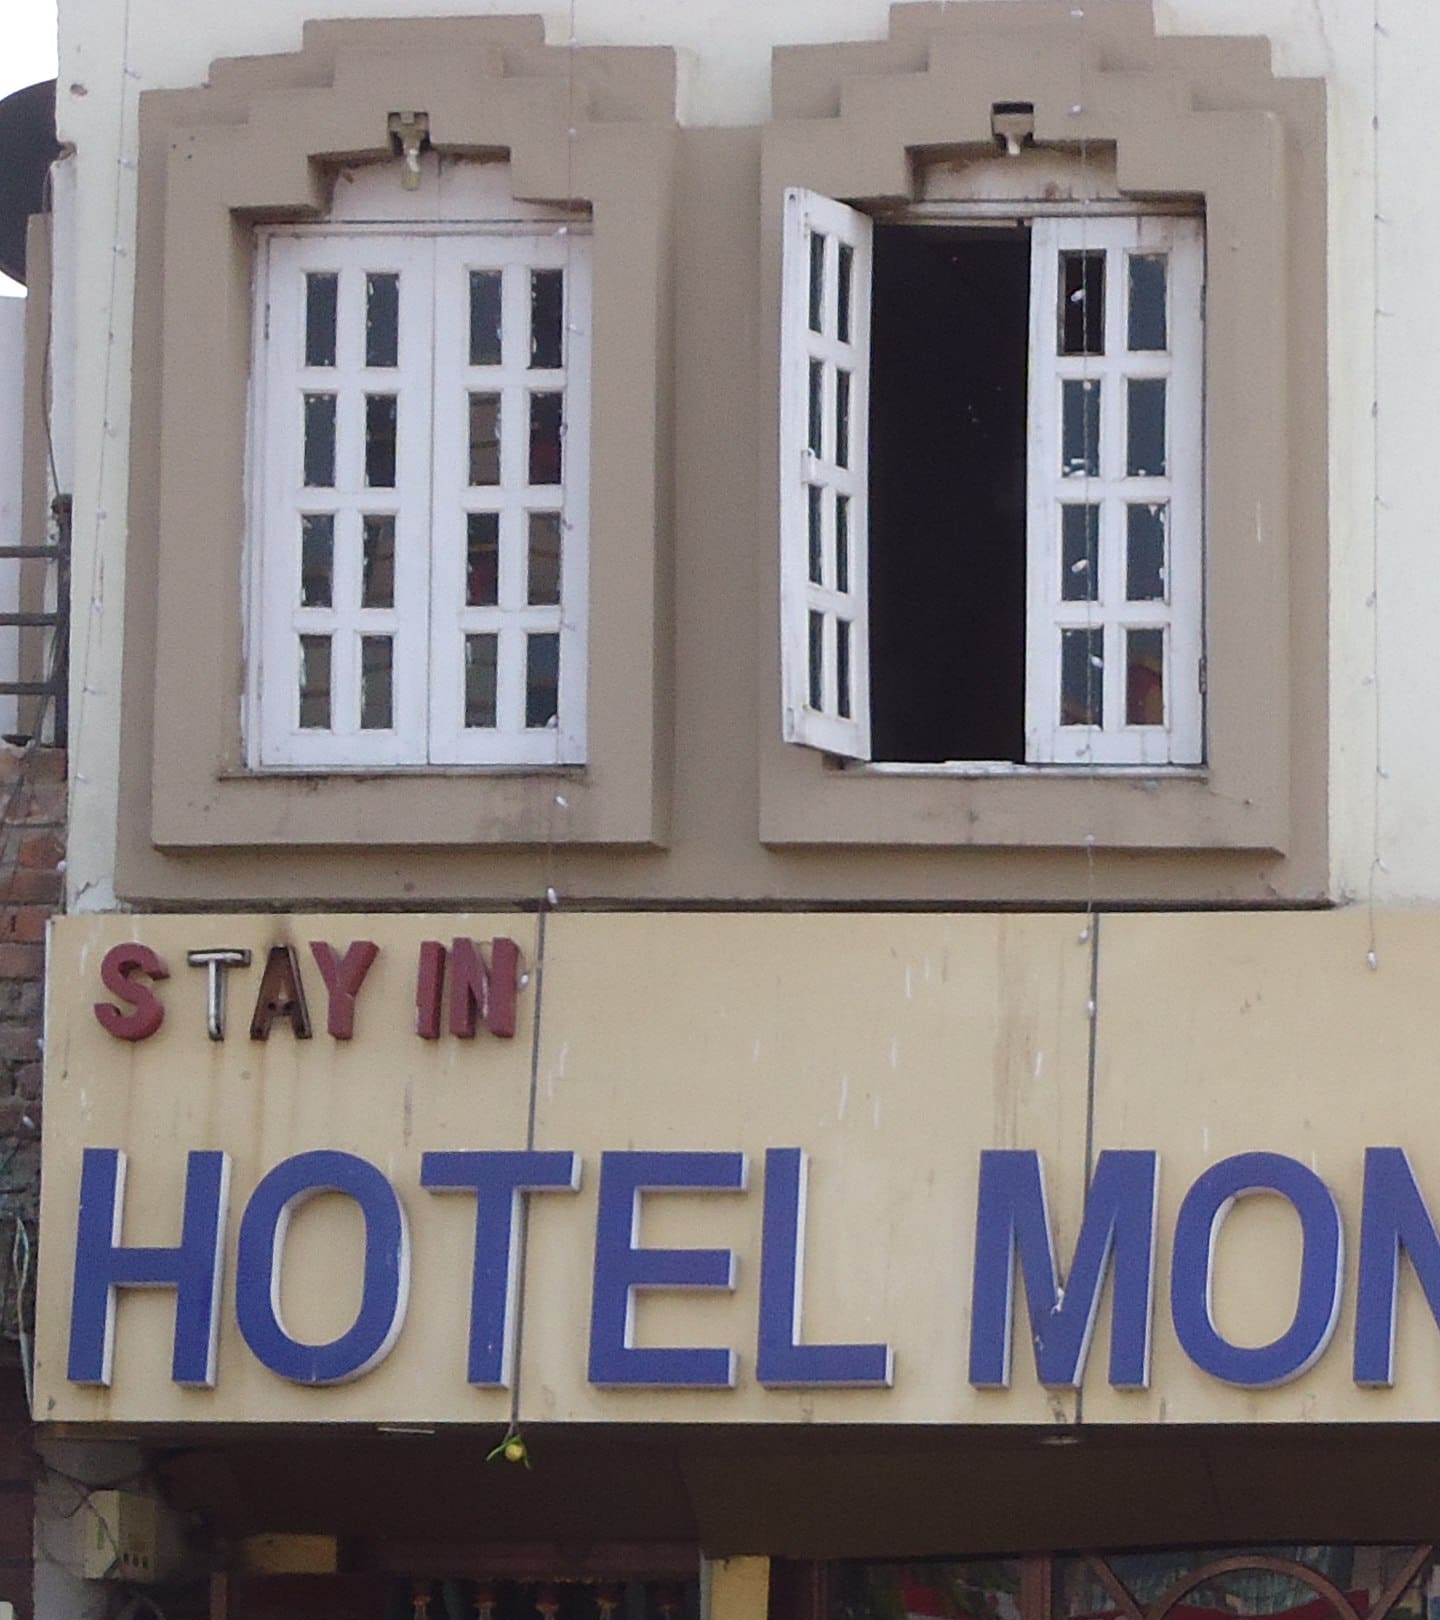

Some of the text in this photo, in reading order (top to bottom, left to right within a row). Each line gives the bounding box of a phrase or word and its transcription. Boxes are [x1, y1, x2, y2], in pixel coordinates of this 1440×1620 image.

[93, 935, 521, 1042] STAY IN
[66, 1146, 895, 1391] HOTEL
